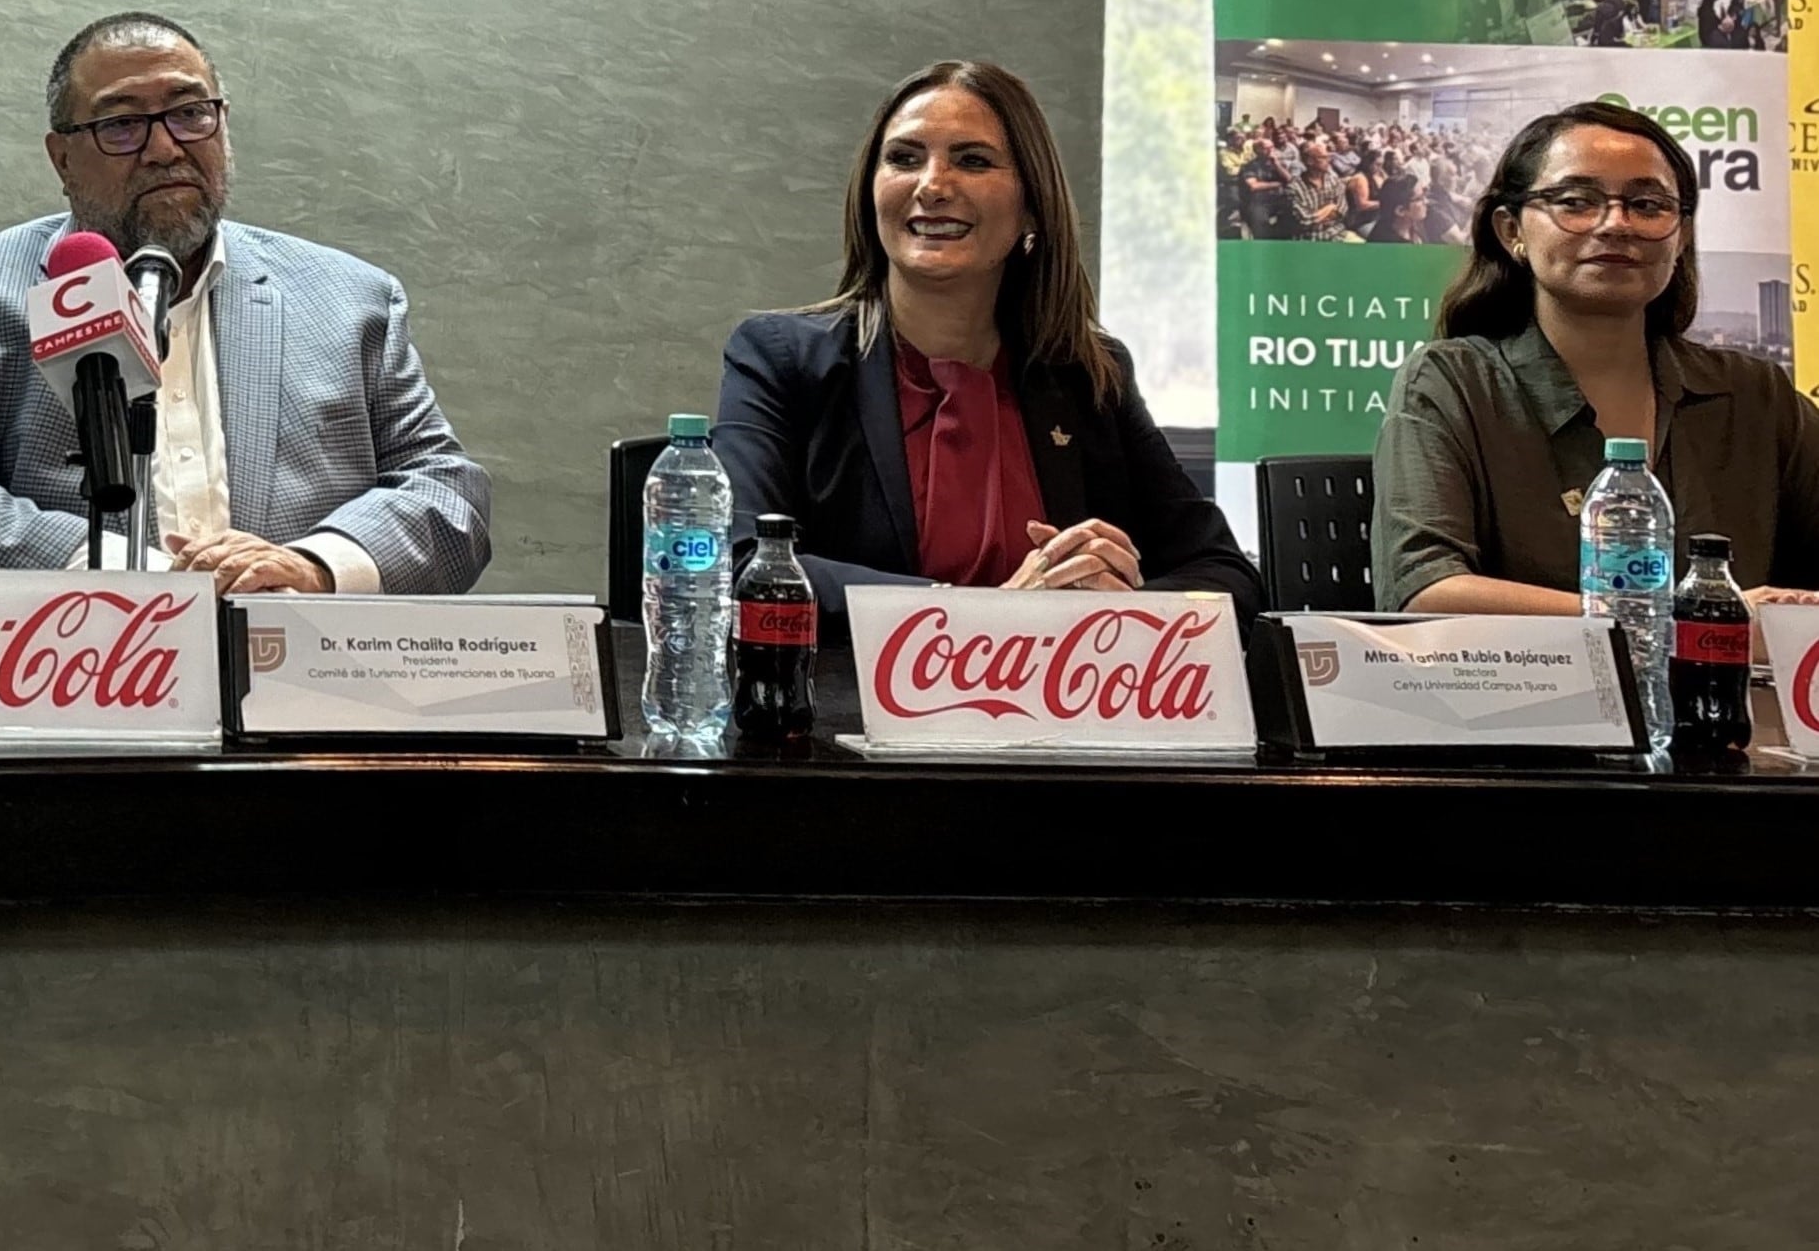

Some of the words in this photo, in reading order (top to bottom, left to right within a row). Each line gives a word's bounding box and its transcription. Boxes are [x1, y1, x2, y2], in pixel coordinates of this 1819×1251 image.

[52, 275, 95, 318] C
[1248, 292, 1431, 321] INICIATI
[33, 315, 123, 354] CAMPESTRE
[1248, 335, 1317, 367] RIO
[1325, 337, 1426, 369] TIJU
[672, 536, 715, 558] ciel
[1627, 555, 1667, 577] ciel
[320, 637, 342, 652] Dr.
[346, 637, 392, 652] Karim
[396, 637, 454, 652] Chalita
[459, 637, 538, 655] Rodríguez
[402, 655, 459, 666] Presidente
[873, 606, 1222, 722] Coca-Cola
[1364, 650, 1404, 664] Mtra.
[1461, 649, 1502, 664] Rubio
[1504, 649, 1573, 667] Bojórquez
[308, 667, 349, 679] Comité
[351, 668, 366, 679] de
[369, 668, 408, 679] Turismo
[419, 668, 498, 679] Convenciones
[500, 668, 515, 679] de
[517, 668, 556, 681] Tijuana
[1453, 667, 1498, 678] Directora
[1481, 680, 1523, 692] Campus
